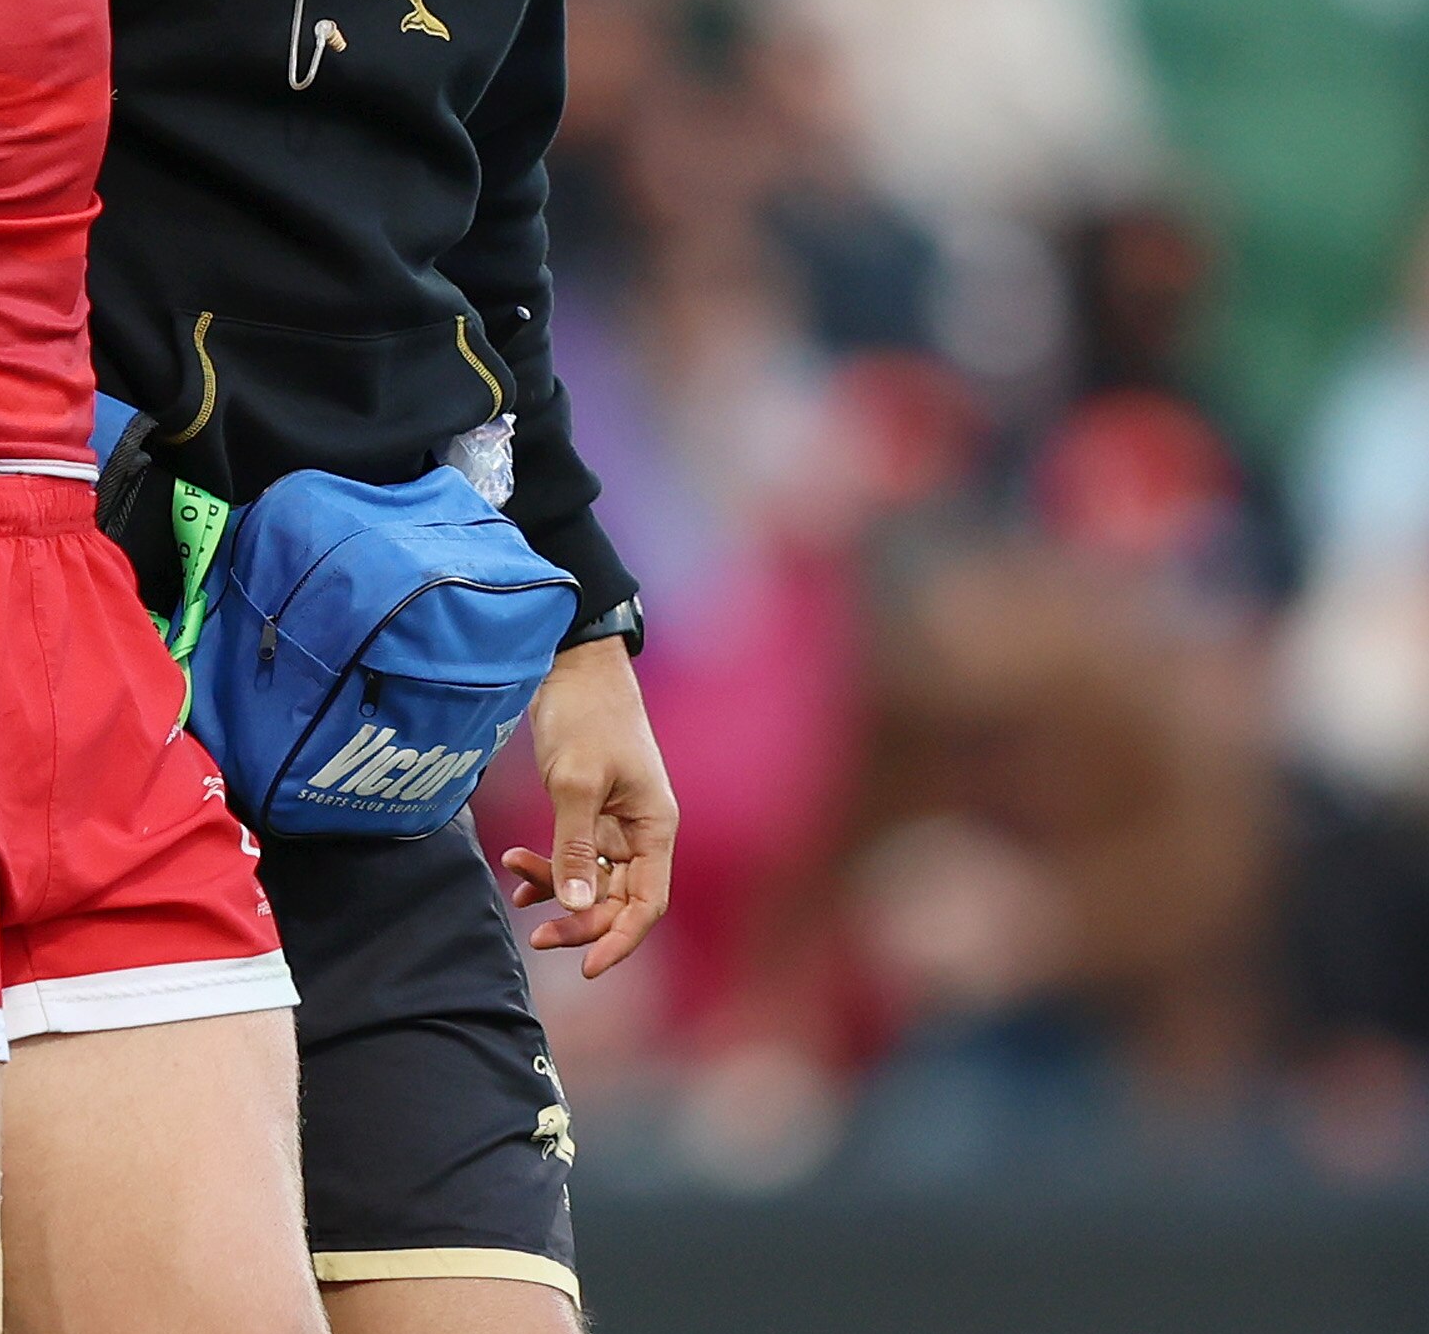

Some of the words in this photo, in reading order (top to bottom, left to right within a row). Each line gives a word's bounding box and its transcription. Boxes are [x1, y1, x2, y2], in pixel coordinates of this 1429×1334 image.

[307, 723, 483, 801] Victor
[297, 789, 350, 807] SPORTS
[351, 799, 386, 813] CLUB
